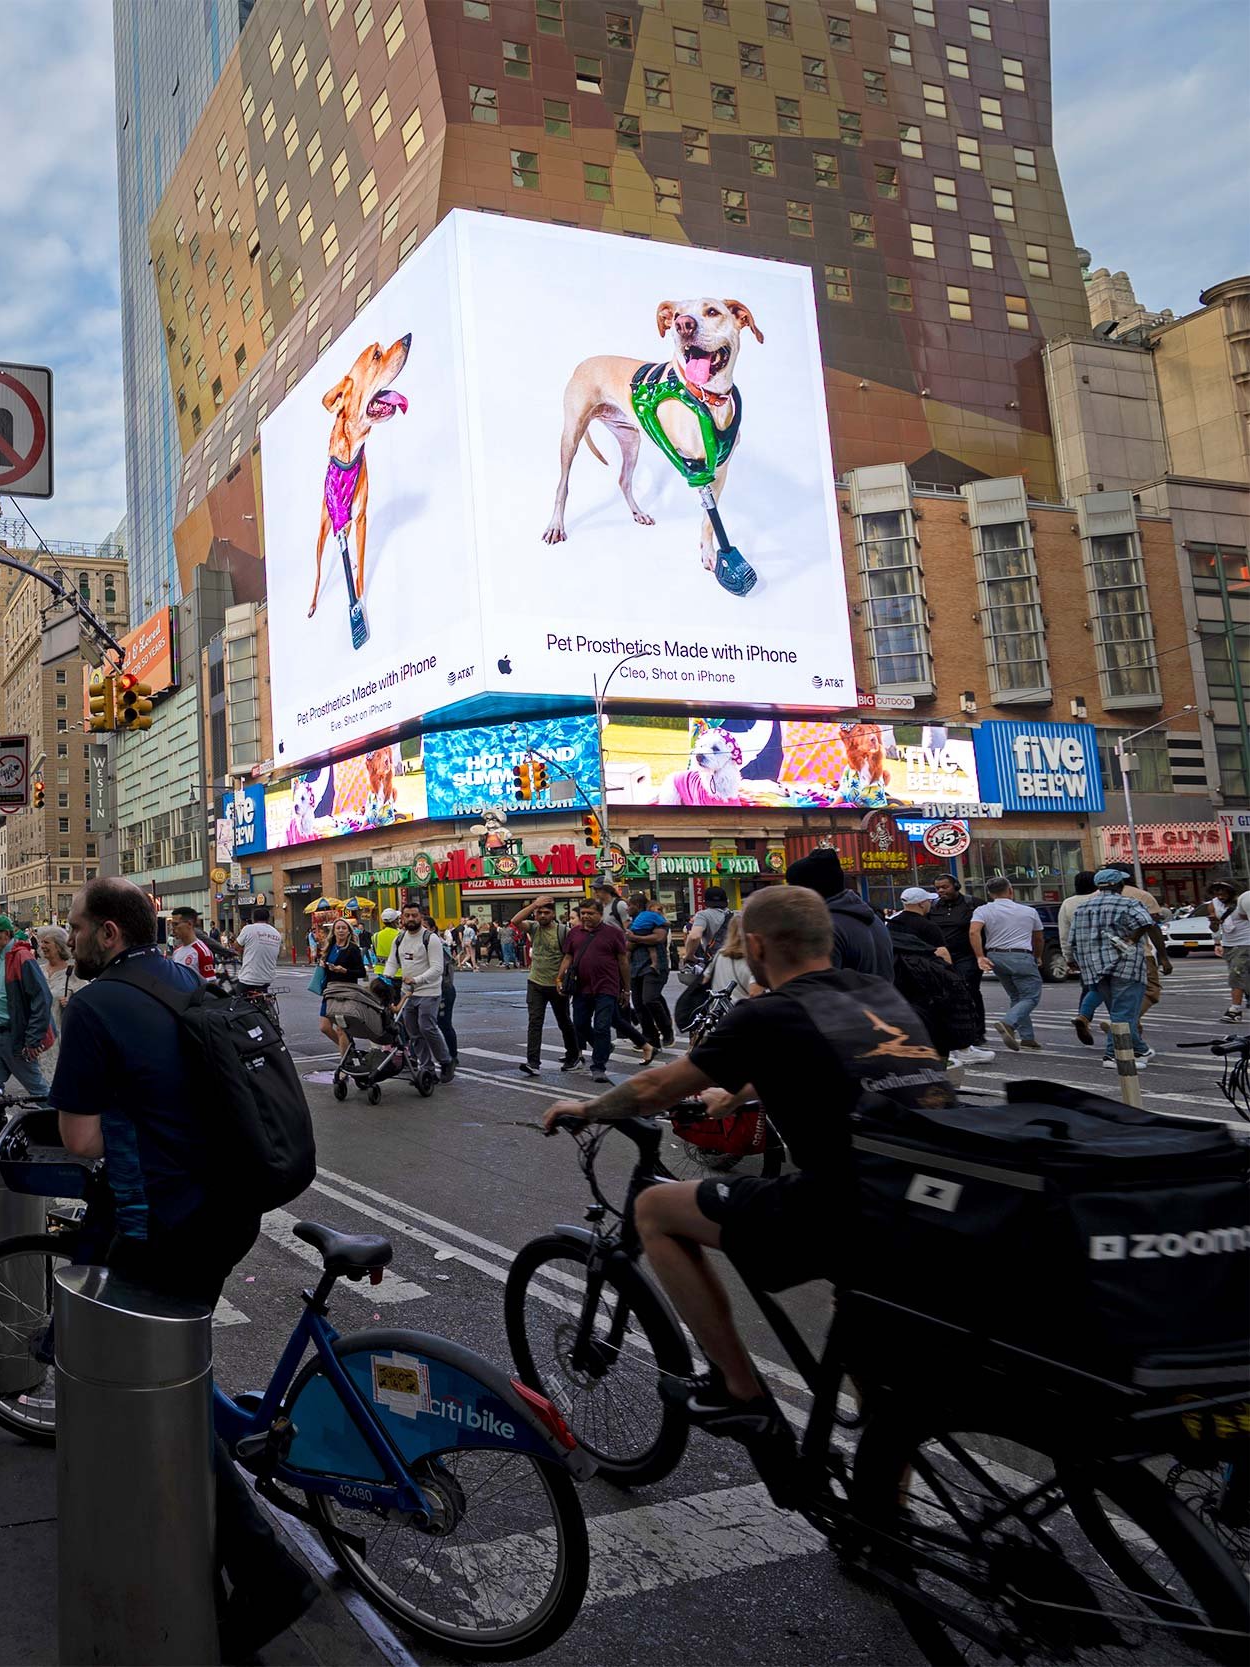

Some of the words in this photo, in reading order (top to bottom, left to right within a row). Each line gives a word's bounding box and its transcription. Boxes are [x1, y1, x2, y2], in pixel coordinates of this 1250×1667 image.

[546, 633, 572, 651] Pet
[576, 635, 661, 656] Prosthetics
[664, 641, 708, 659] Made
[711, 643, 744, 661] with
[746, 645, 797, 663] iPhone
[457, 666, 474, 681] AT&T
[619, 666, 649, 681] Cleo,
[652, 668, 678, 681] Shot
[681, 671, 695, 681] on
[698, 670, 735, 683] iPhone
[297, 713, 309, 726] Pet
[309, 694, 351, 721] Prosthetics
[352, 681, 377, 703] Made
[378, 670, 399, 690] with
[400, 655, 437, 681] iPhone
[824, 678, 844, 688] AT&T
[858, 695, 874, 707] BIG
[876, 696, 913, 707] OUTDOOR
[344, 712, 359, 727] Shot
[359, 710, 368, 720] on
[368, 700, 392, 718] iPhone
[466, 753, 505, 770] HOT
[1012, 734, 1085, 772] five
[452, 770, 524, 787] SUMM
[1016, 772, 1087, 797] BELOW
[92, 757, 106, 819] WESTIN
[922, 802, 956, 818] five
[957, 801, 1004, 818] BELOW
[1220, 815, 1234, 826] NY
[1162, 830, 1220, 845] GUYS
[434, 849, 484, 880] villa
[531, 844, 597, 875] villa
[646, 858, 711, 874] SROMBOLI
[729, 858, 760, 873] PASTA
[468, 879, 488, 888] PIZZA
[493, 878, 514, 887] PASTA
[521, 877, 574, 886] CHEESESTEAKS
[430, 1398, 463, 1423] citi
[466, 1405, 516, 1440] bike
[338, 1484, 373, 1503] 42480
